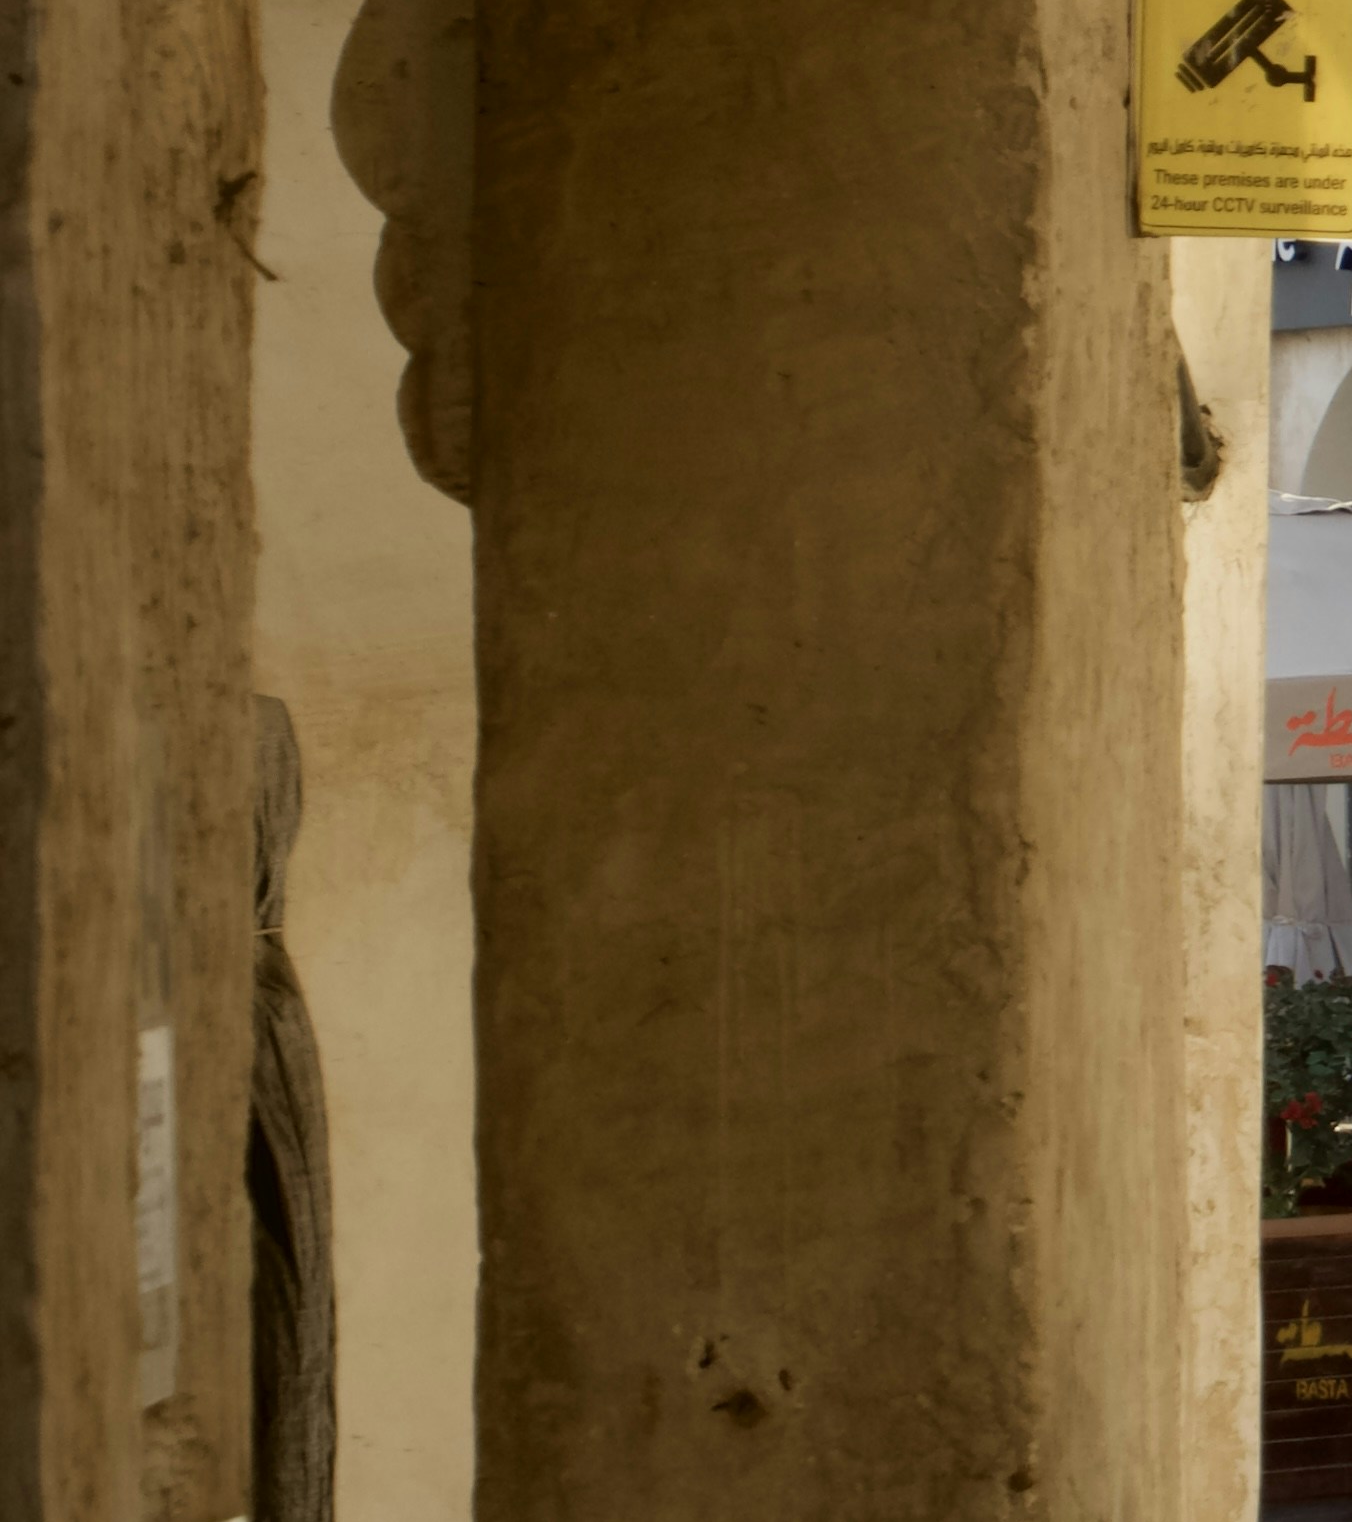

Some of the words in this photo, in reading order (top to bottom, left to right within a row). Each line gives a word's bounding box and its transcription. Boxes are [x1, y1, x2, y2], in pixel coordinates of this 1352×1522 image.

[1154, 169, 1198, 185] These
[1203, 172, 1270, 188] premises
[1275, 176, 1298, 189] are
[1304, 176, 1346, 190] under
[1151, 194, 1207, 212] 24-hour
[1212, 197, 1255, 213] CCTV
[1259, 199, 1347, 217] surveillance
[1296, 1378, 1348, 1401] BASTA
